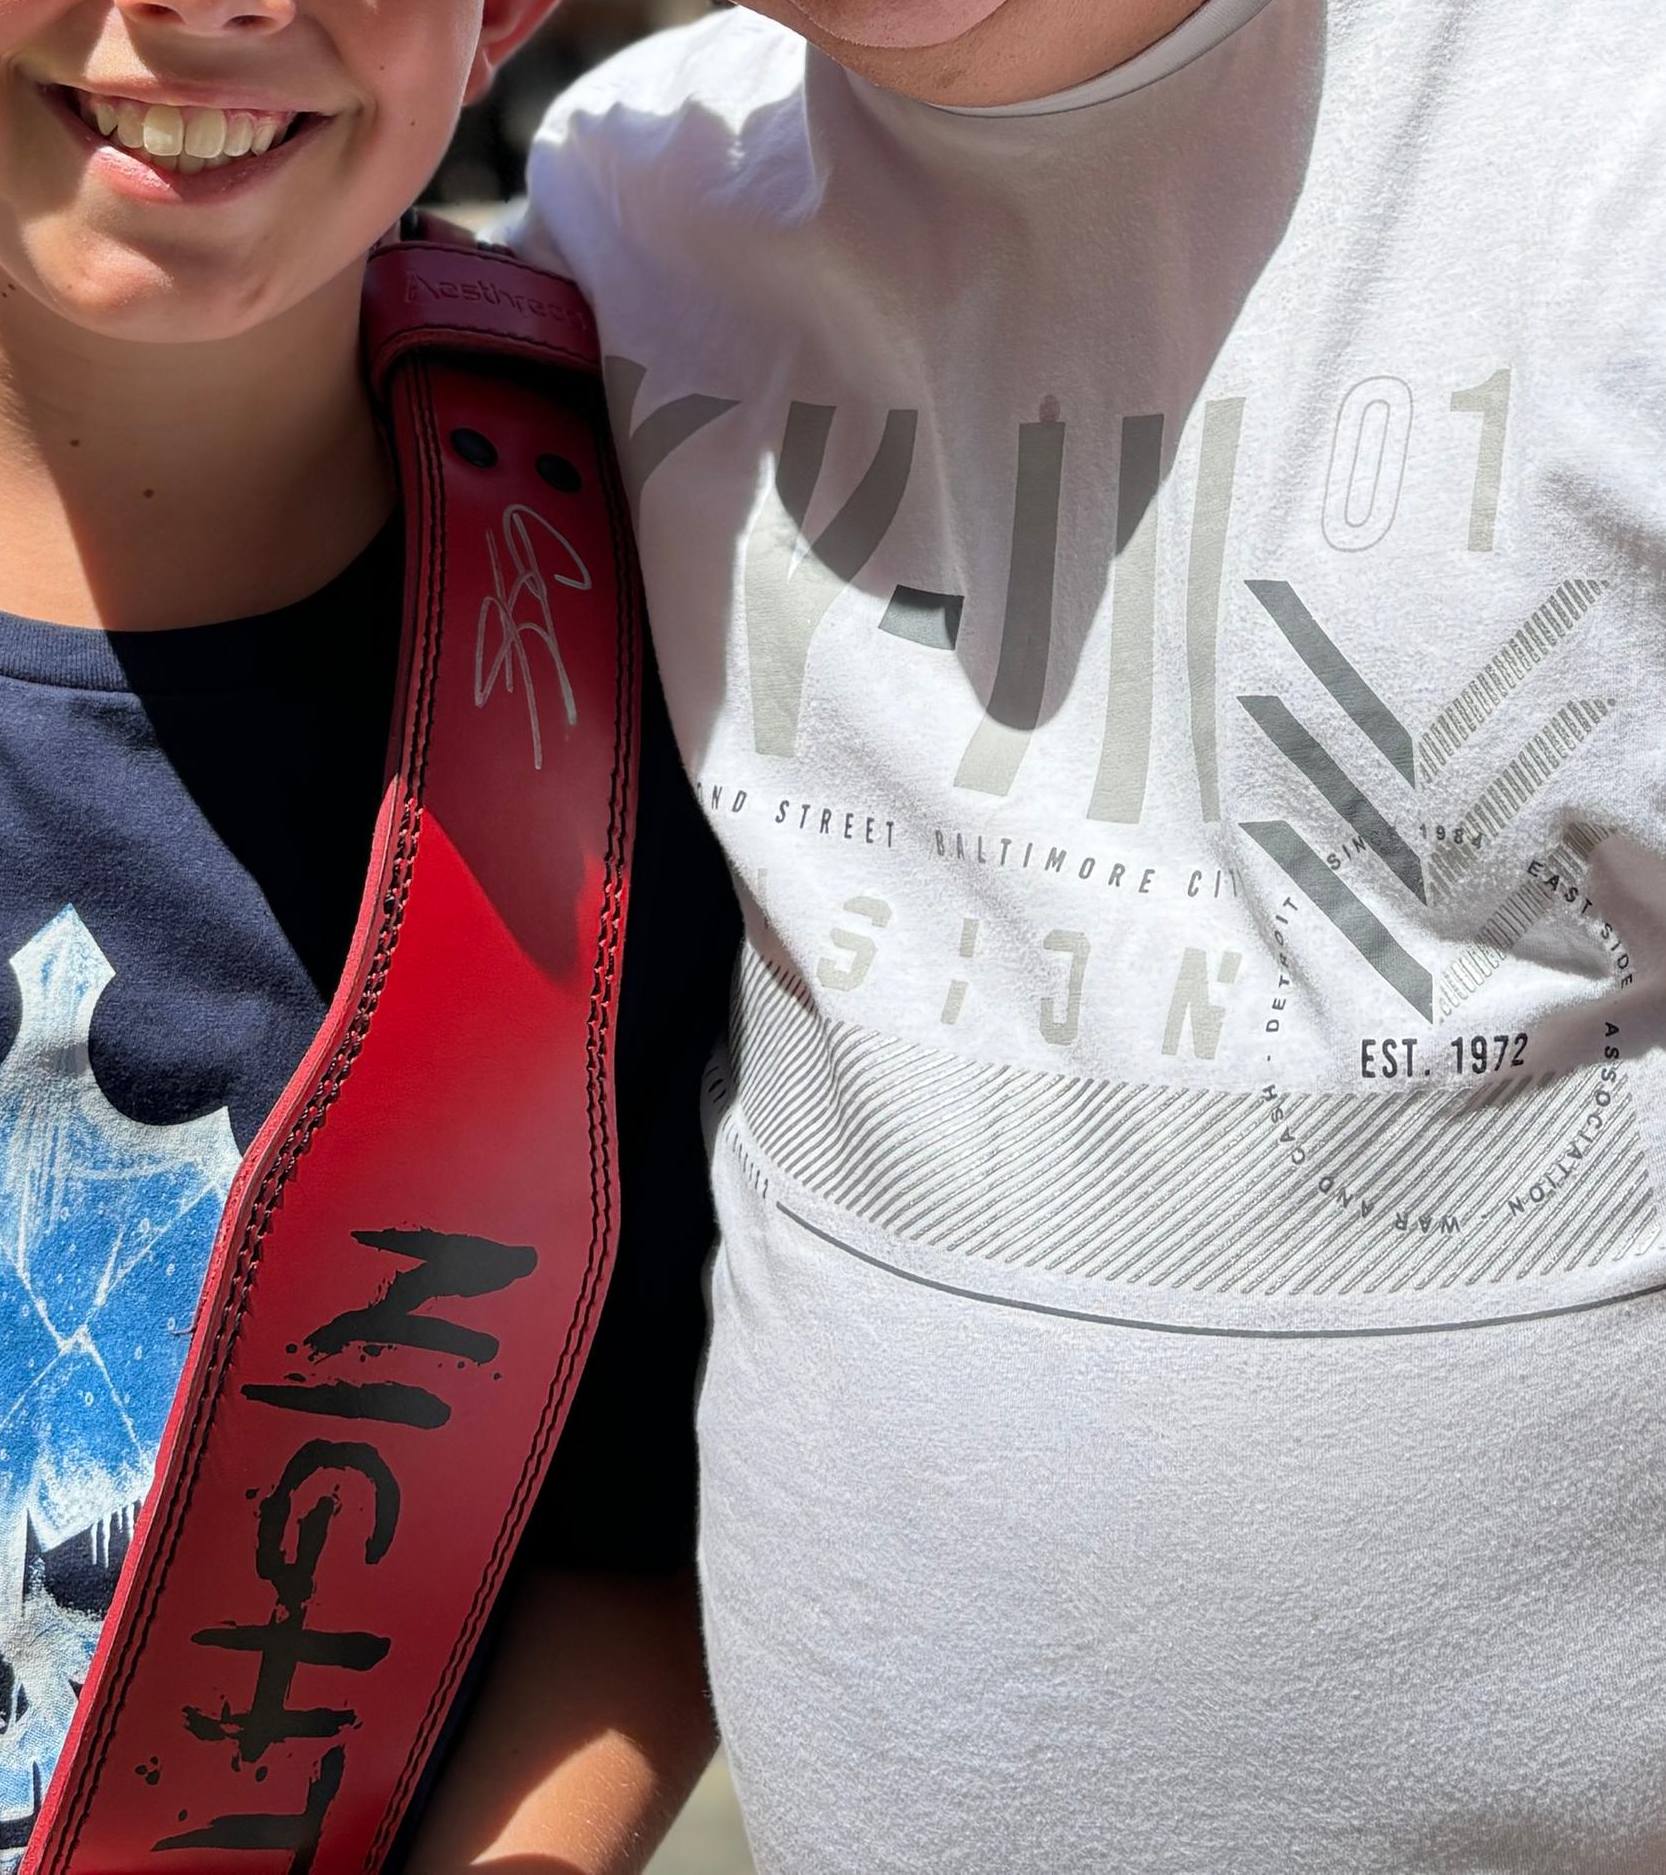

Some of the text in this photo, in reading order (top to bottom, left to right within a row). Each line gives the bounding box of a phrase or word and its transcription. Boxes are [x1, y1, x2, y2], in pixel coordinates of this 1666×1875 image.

[774, 799, 896, 849] STREET
[934, 829, 1157, 895] BALTIMORE
[1265, 896, 1299, 1033] DETROIT
[1361, 1031, 1529, 1079] EST. 1972
[1507, 860, 1634, 1217] EAST SIDE ASSOCIATION
